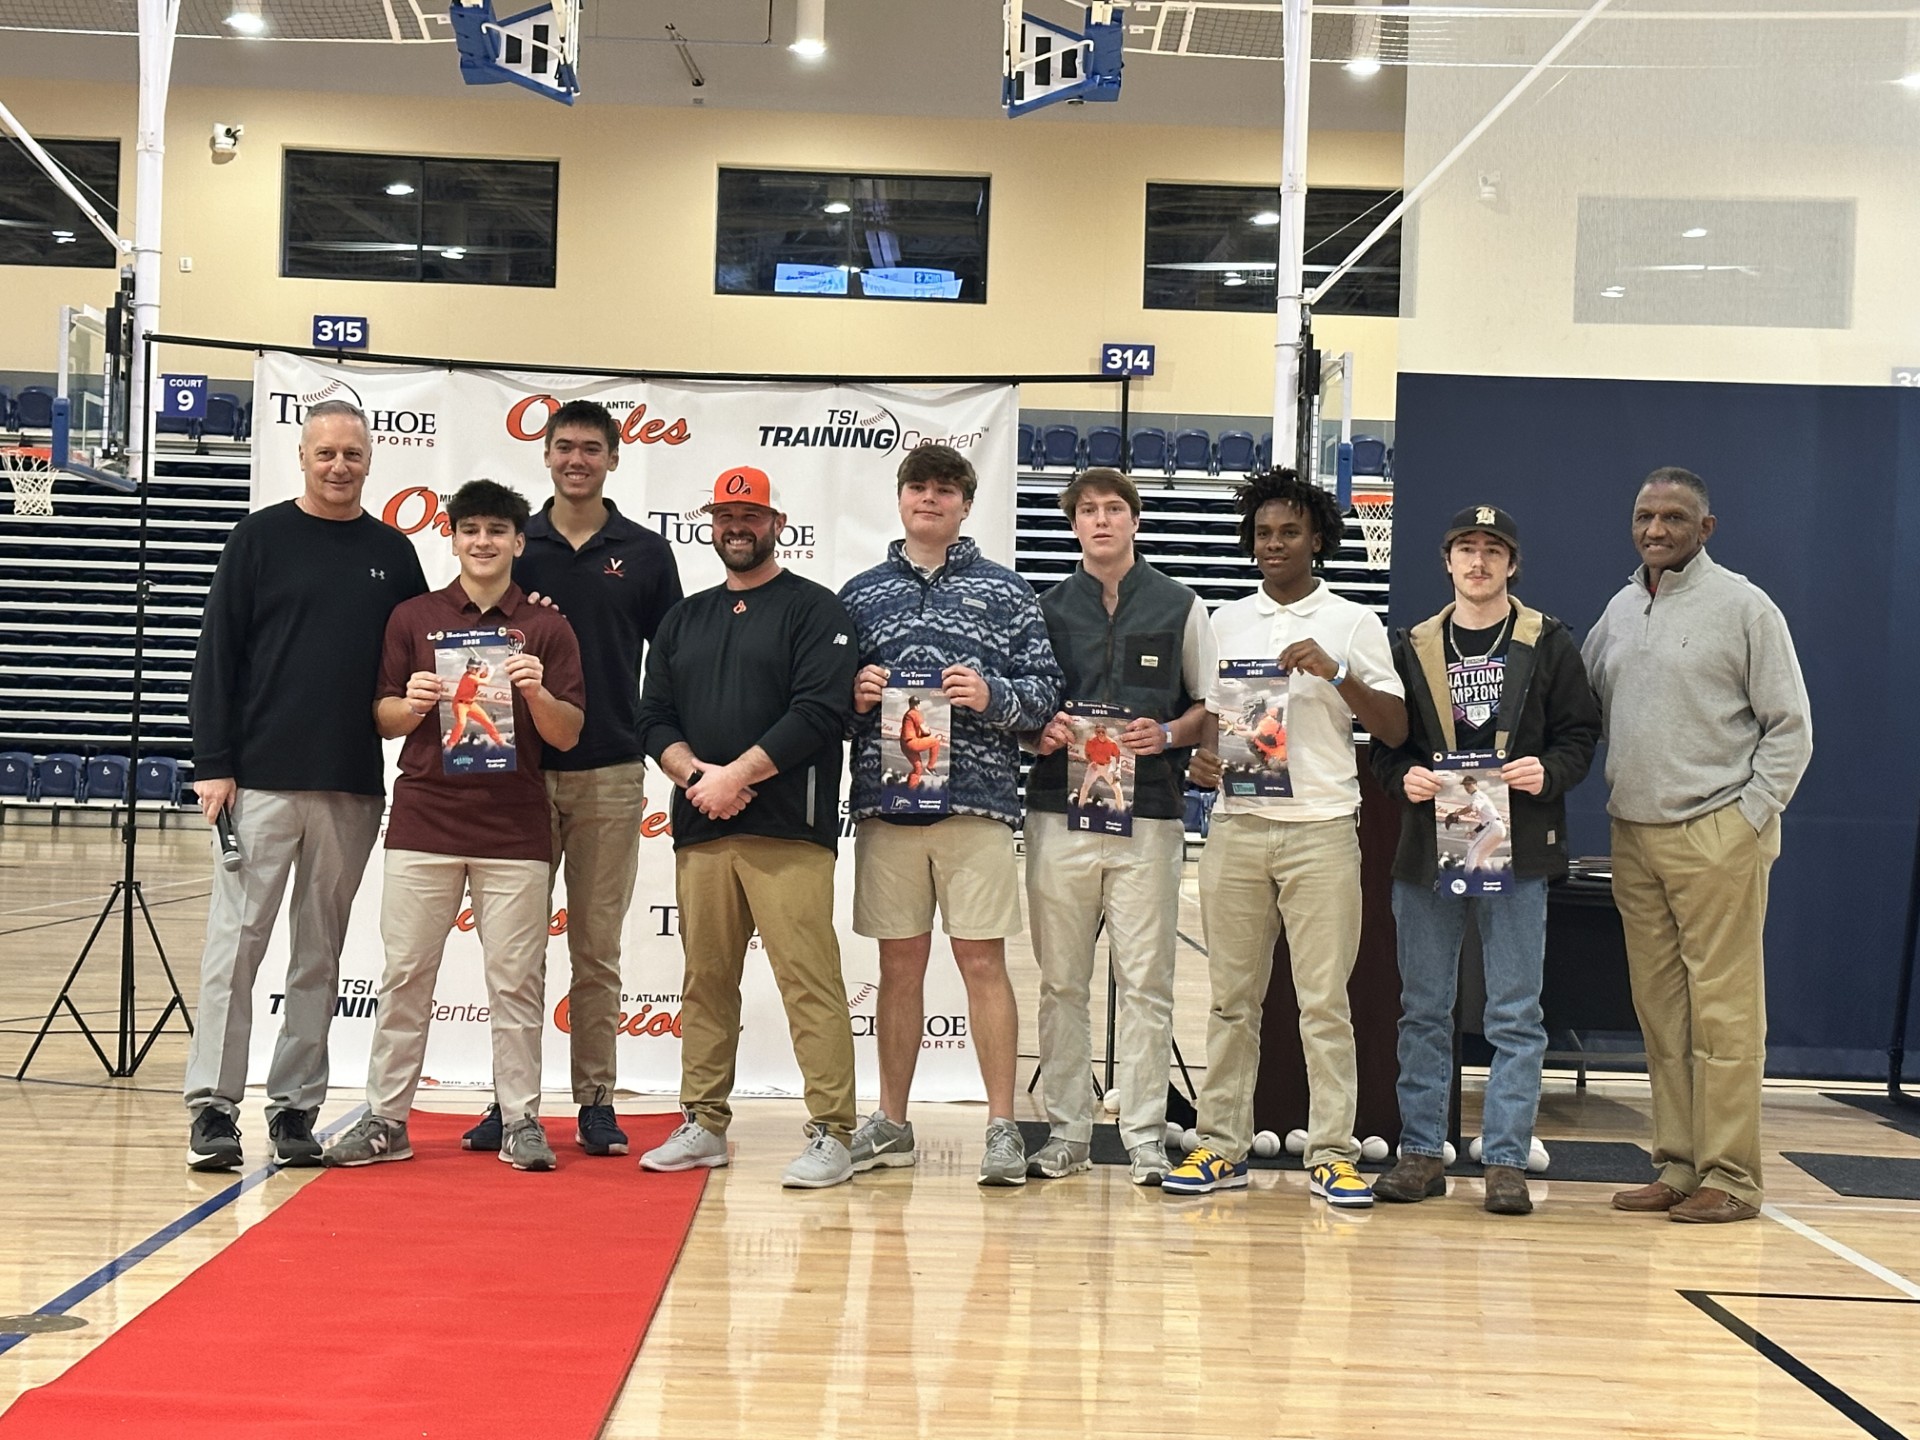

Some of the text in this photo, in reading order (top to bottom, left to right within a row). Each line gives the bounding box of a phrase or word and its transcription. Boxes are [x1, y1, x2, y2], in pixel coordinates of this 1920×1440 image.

[317, 320, 362, 342] 315
[1106, 348, 1150, 370] 314
[169, 379, 203, 388] COURT
[176, 390, 195, 411] 9
[270, 392, 436, 434] TUHOE
[827, 410, 858, 425] TSI
[758, 426, 894, 449] TRAINING
[648, 511, 815, 547] TUCOE
[773, 550, 814, 559] ORTS
[341, 979, 373, 995] TSI
[922, 1040, 965, 1049] ORTS
